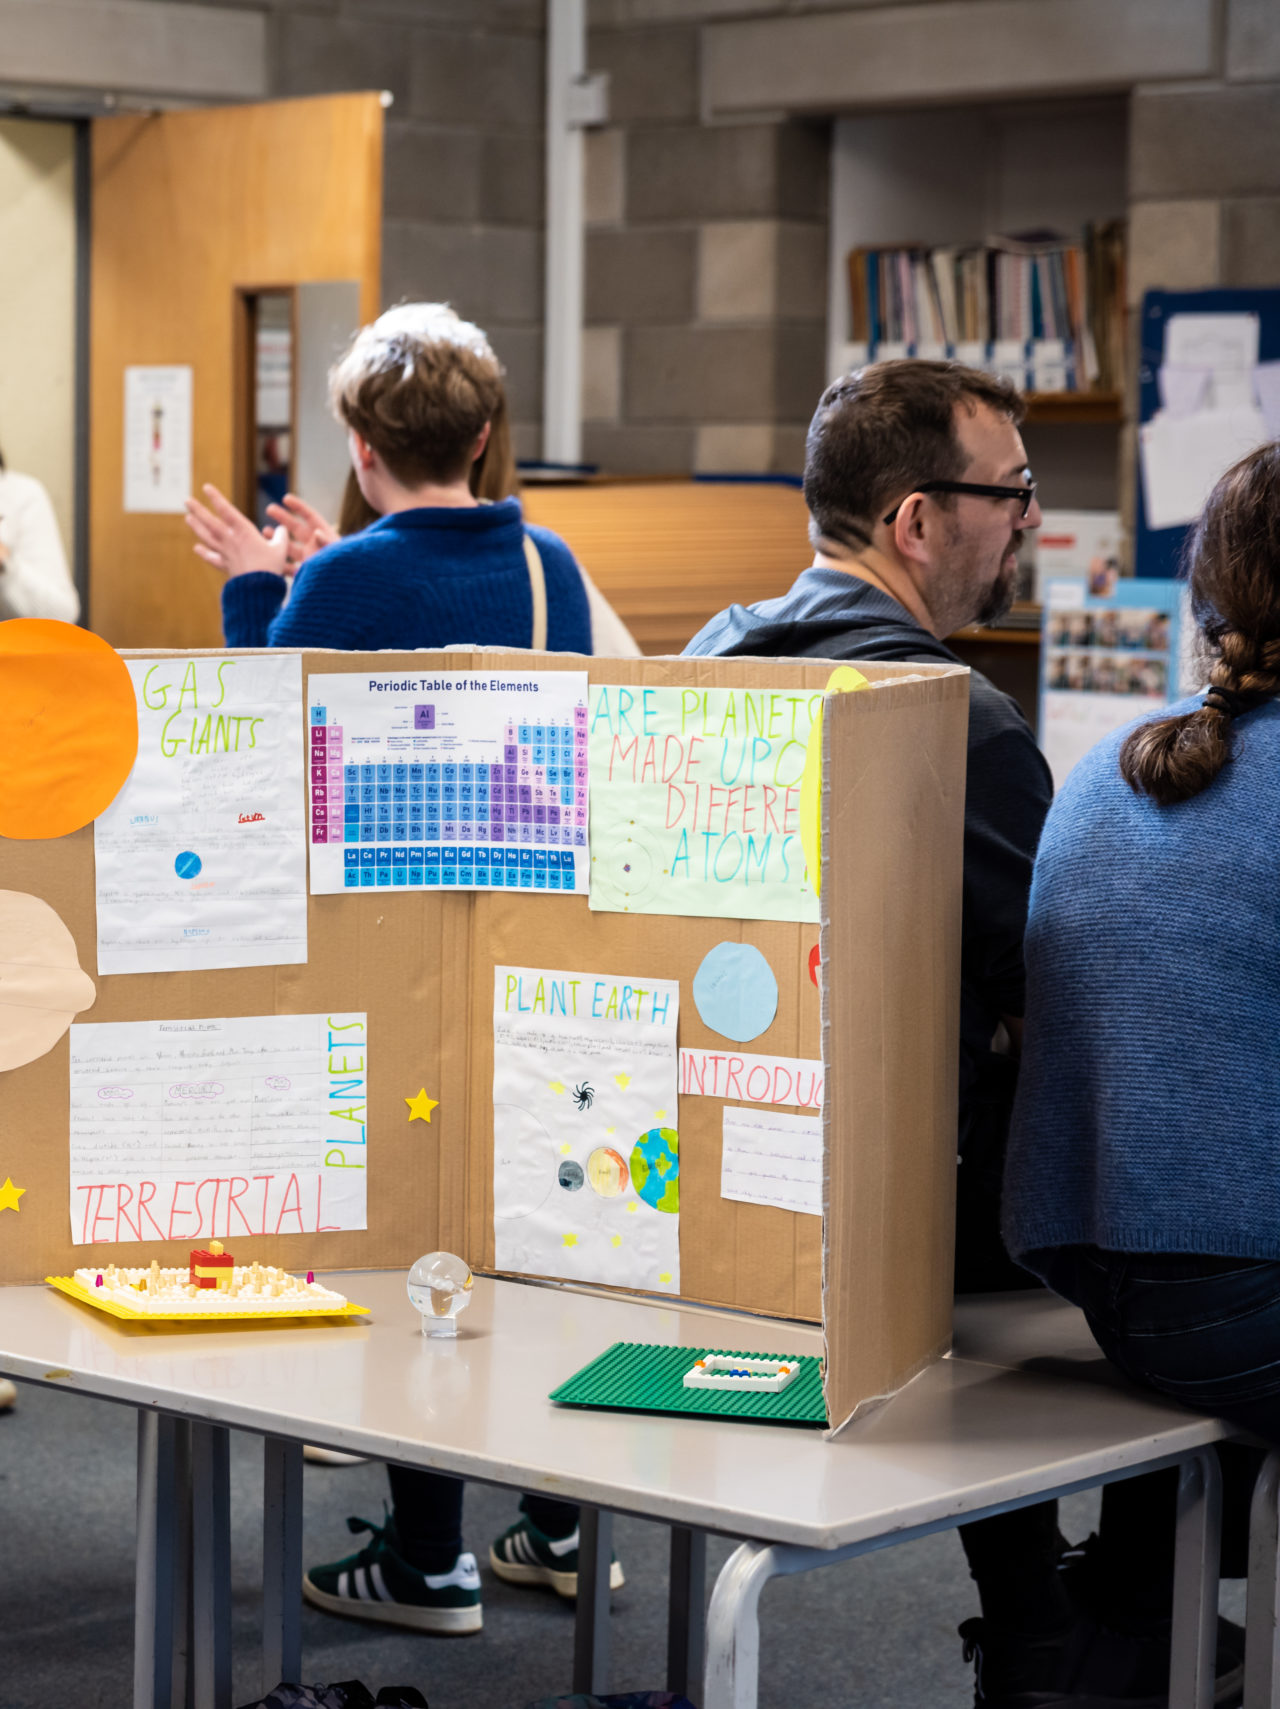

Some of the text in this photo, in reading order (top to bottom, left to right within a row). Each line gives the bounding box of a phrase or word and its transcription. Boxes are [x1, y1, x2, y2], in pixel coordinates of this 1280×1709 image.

[143, 661, 236, 710] GAS
[369, 680, 539, 692] Periodic Table of the Elements
[160, 710, 265, 758] GIANTS
[420, 710, 429, 718] Al
[591, 687, 658, 736] ARE
[609, 734, 808, 787] MADE UP O
[665, 783, 800, 837] DIFFERE
[505, 974, 670, 1025] PLANT EARTH
[325, 1016, 366, 1168] PLANETS
[681, 1052, 823, 1107] INTRODUC
[77, 1172, 341, 1244] TERRESTRIAL
